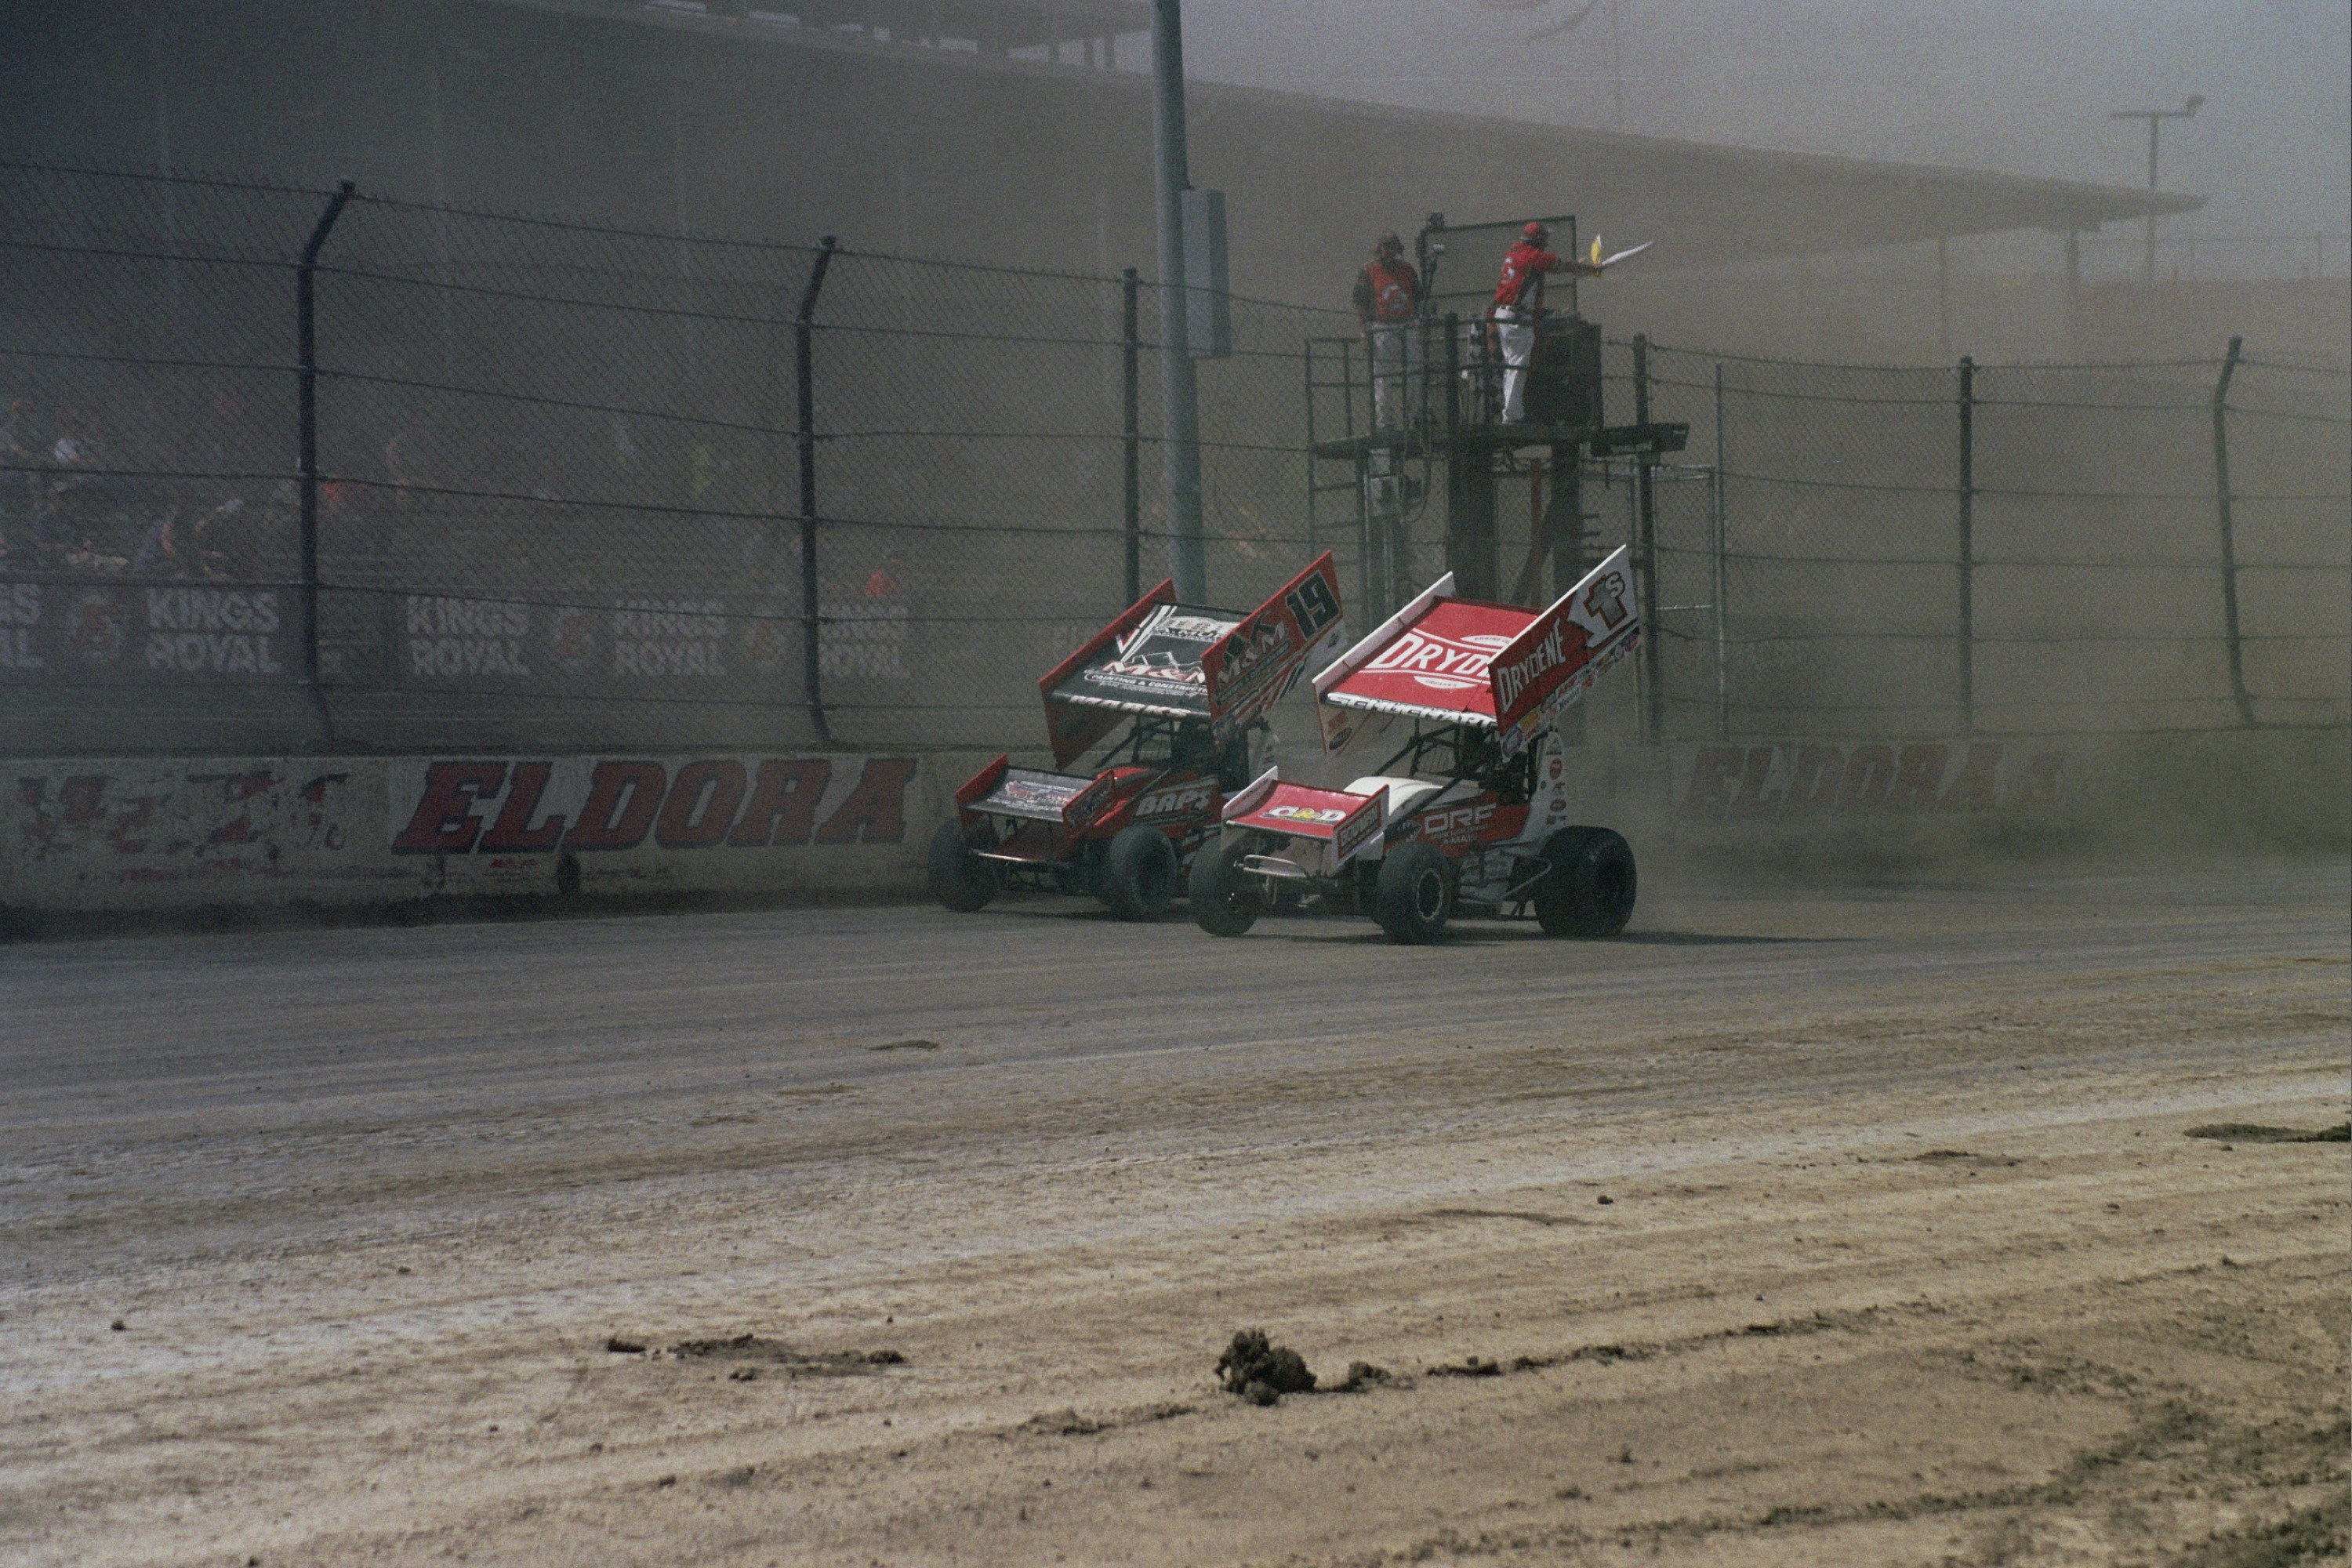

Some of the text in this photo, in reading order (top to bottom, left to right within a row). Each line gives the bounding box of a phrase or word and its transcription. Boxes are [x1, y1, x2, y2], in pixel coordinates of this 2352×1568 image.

[144, 587, 281, 632] KINGS
[406, 596, 528, 637] KINGS
[613, 599, 726, 638] KINGS
[1285, 570, 1340, 641] 19
[144, 633, 281, 674] ROYAL
[408, 639, 530, 676] ROYAL
[614, 641, 727, 677] ROYAL
[1497, 616, 1566, 714] DRYDENE
[1677, 741, 2004, 818] ELDORA
[394, 757, 920, 854] ELDORA
[1135, 789, 1212, 817] BAPS
[1424, 802, 1497, 835] DRF
